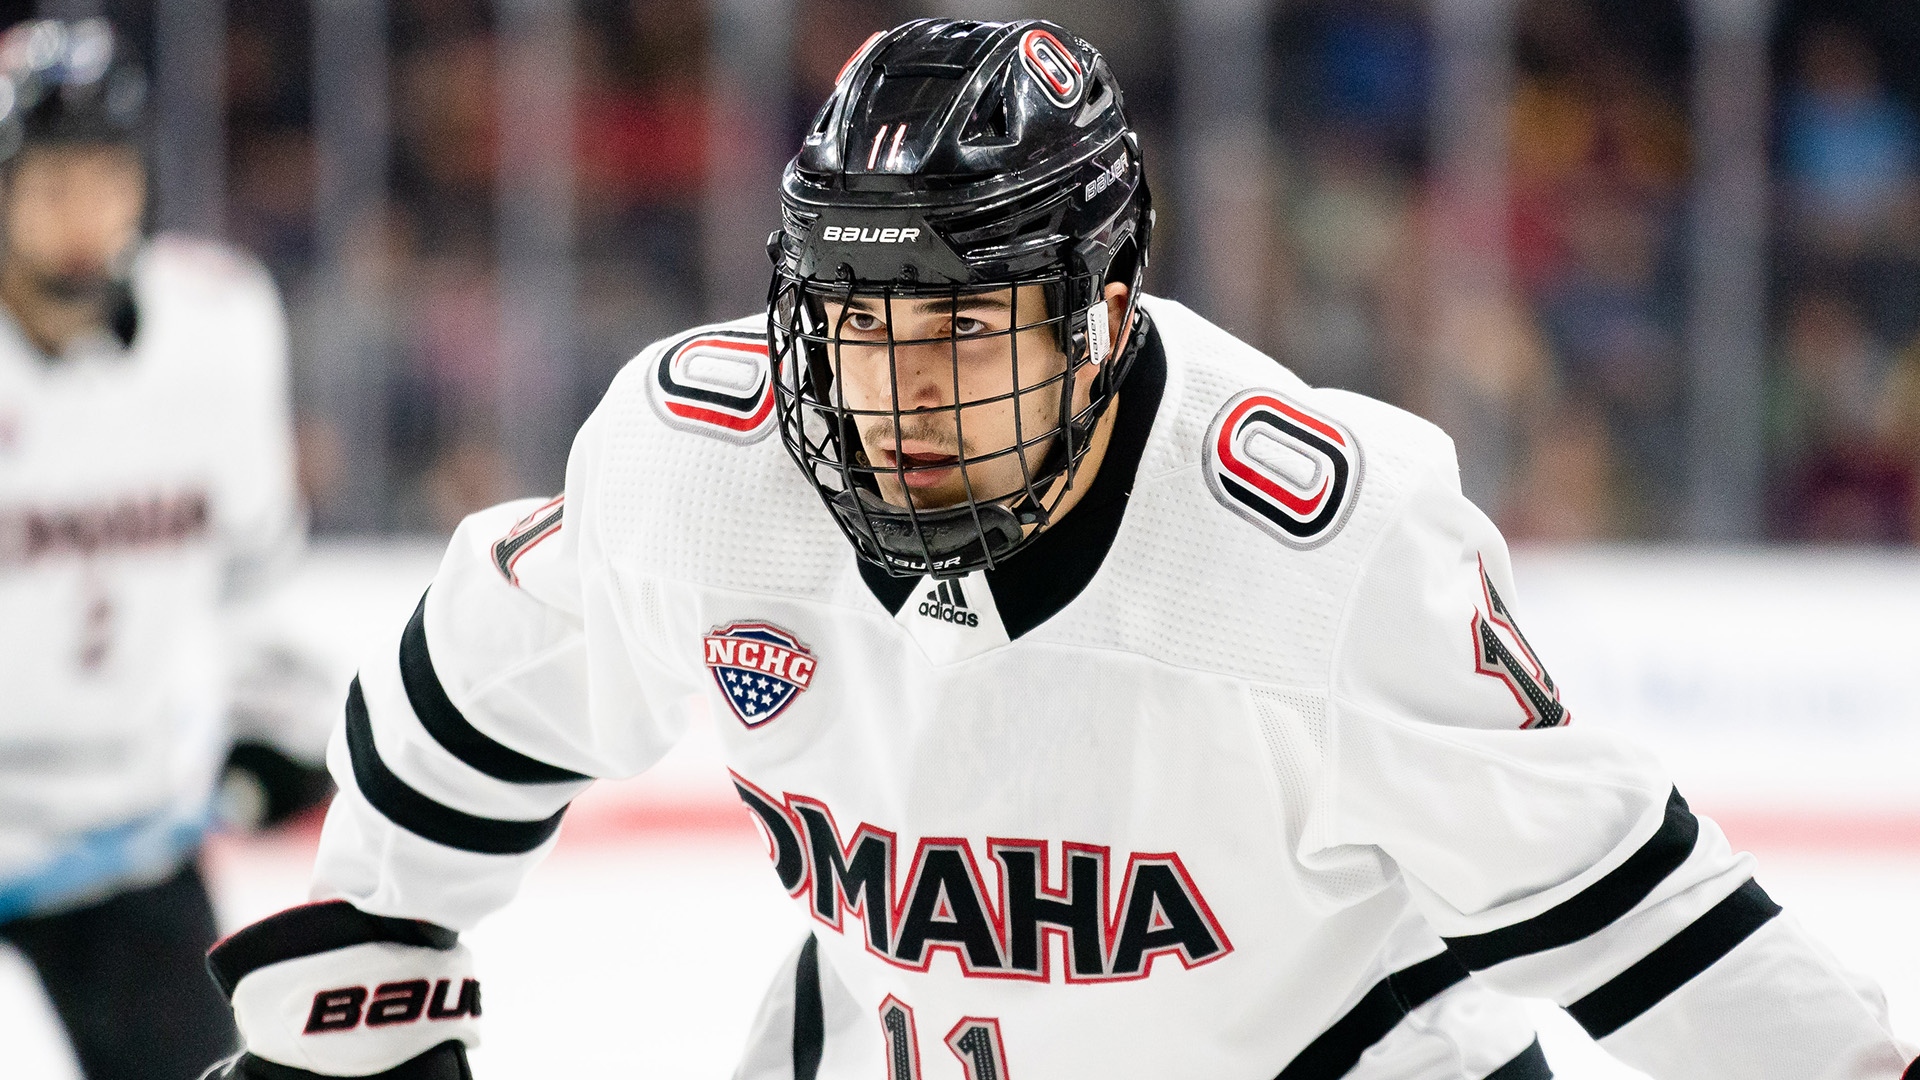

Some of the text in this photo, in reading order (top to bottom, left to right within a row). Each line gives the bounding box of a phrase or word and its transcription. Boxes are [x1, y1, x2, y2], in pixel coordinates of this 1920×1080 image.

[867, 123, 907, 170] 11
[1085, 151, 1129, 202] BAUER
[823, 225, 922, 244] BAUER
[918, 601, 979, 628] adidas
[706, 638, 814, 685] NCHC
[879, 992, 1010, 1080] 11
